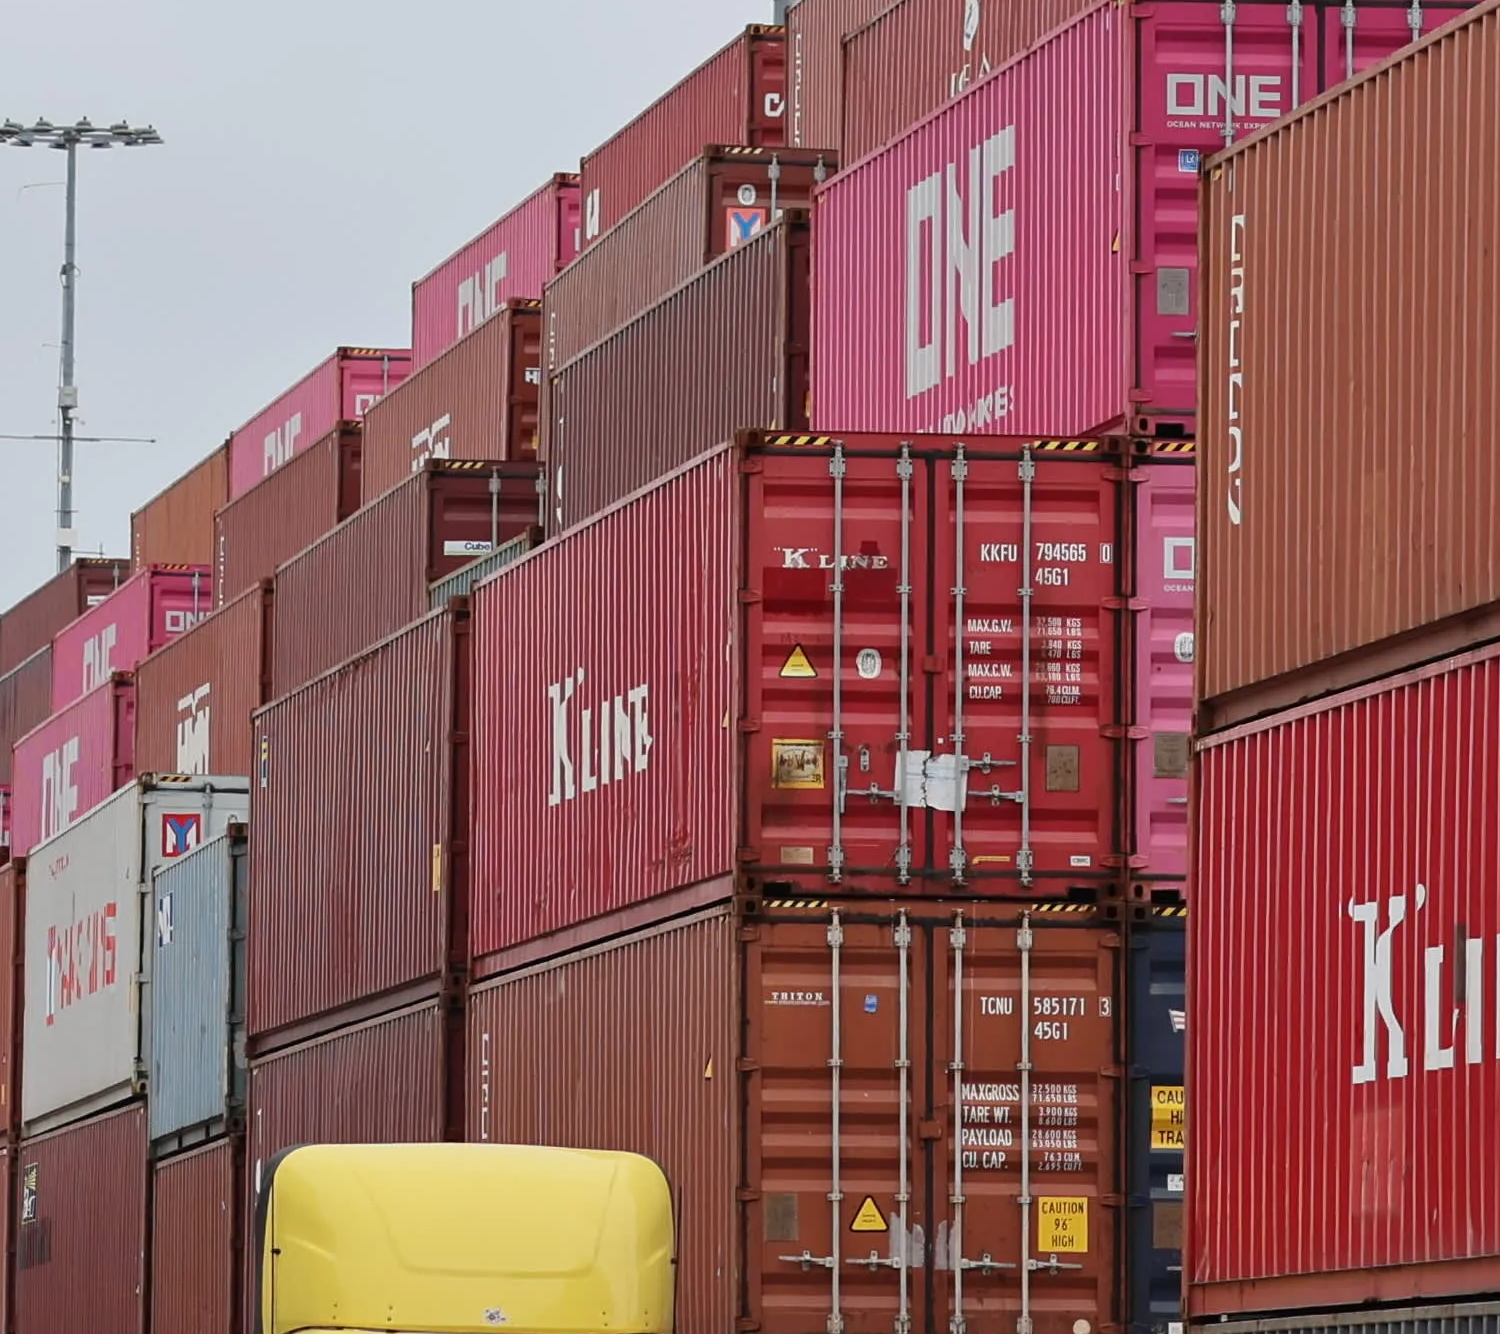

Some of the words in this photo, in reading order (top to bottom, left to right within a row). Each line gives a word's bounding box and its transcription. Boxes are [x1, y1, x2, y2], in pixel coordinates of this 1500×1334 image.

[1166, 74, 1281, 117] ONE
[1166, 121, 1196, 129] OCEAN
[907, 125, 1015, 400] ONE
[980, 544, 1018, 562] KKFU
[1035, 543, 1087, 562] 794565
[1035, 568, 1069, 586] 45G1
[969, 641, 992, 655] TARE
[771, 992, 824, 1001] TRITON
[980, 997, 1013, 1015] TCNU
[1033, 997, 1085, 1016] 585171
[1100, 997, 1111, 1016] 3
[1034, 1022, 1068, 1040] 45G1
[961, 1083, 1019, 1101] MAXGROSS
[963, 1106, 989, 1124] TARE
[994, 1107, 1012, 1124] WT.
[962, 1129, 1013, 1147] PAYLOAD
[962, 1151, 979, 1168] CU.
[982, 1152, 1008, 1168] CAP.
[1041, 1202, 1084, 1214] CAUTION
[1052, 1235, 1074, 1248] HIGH
